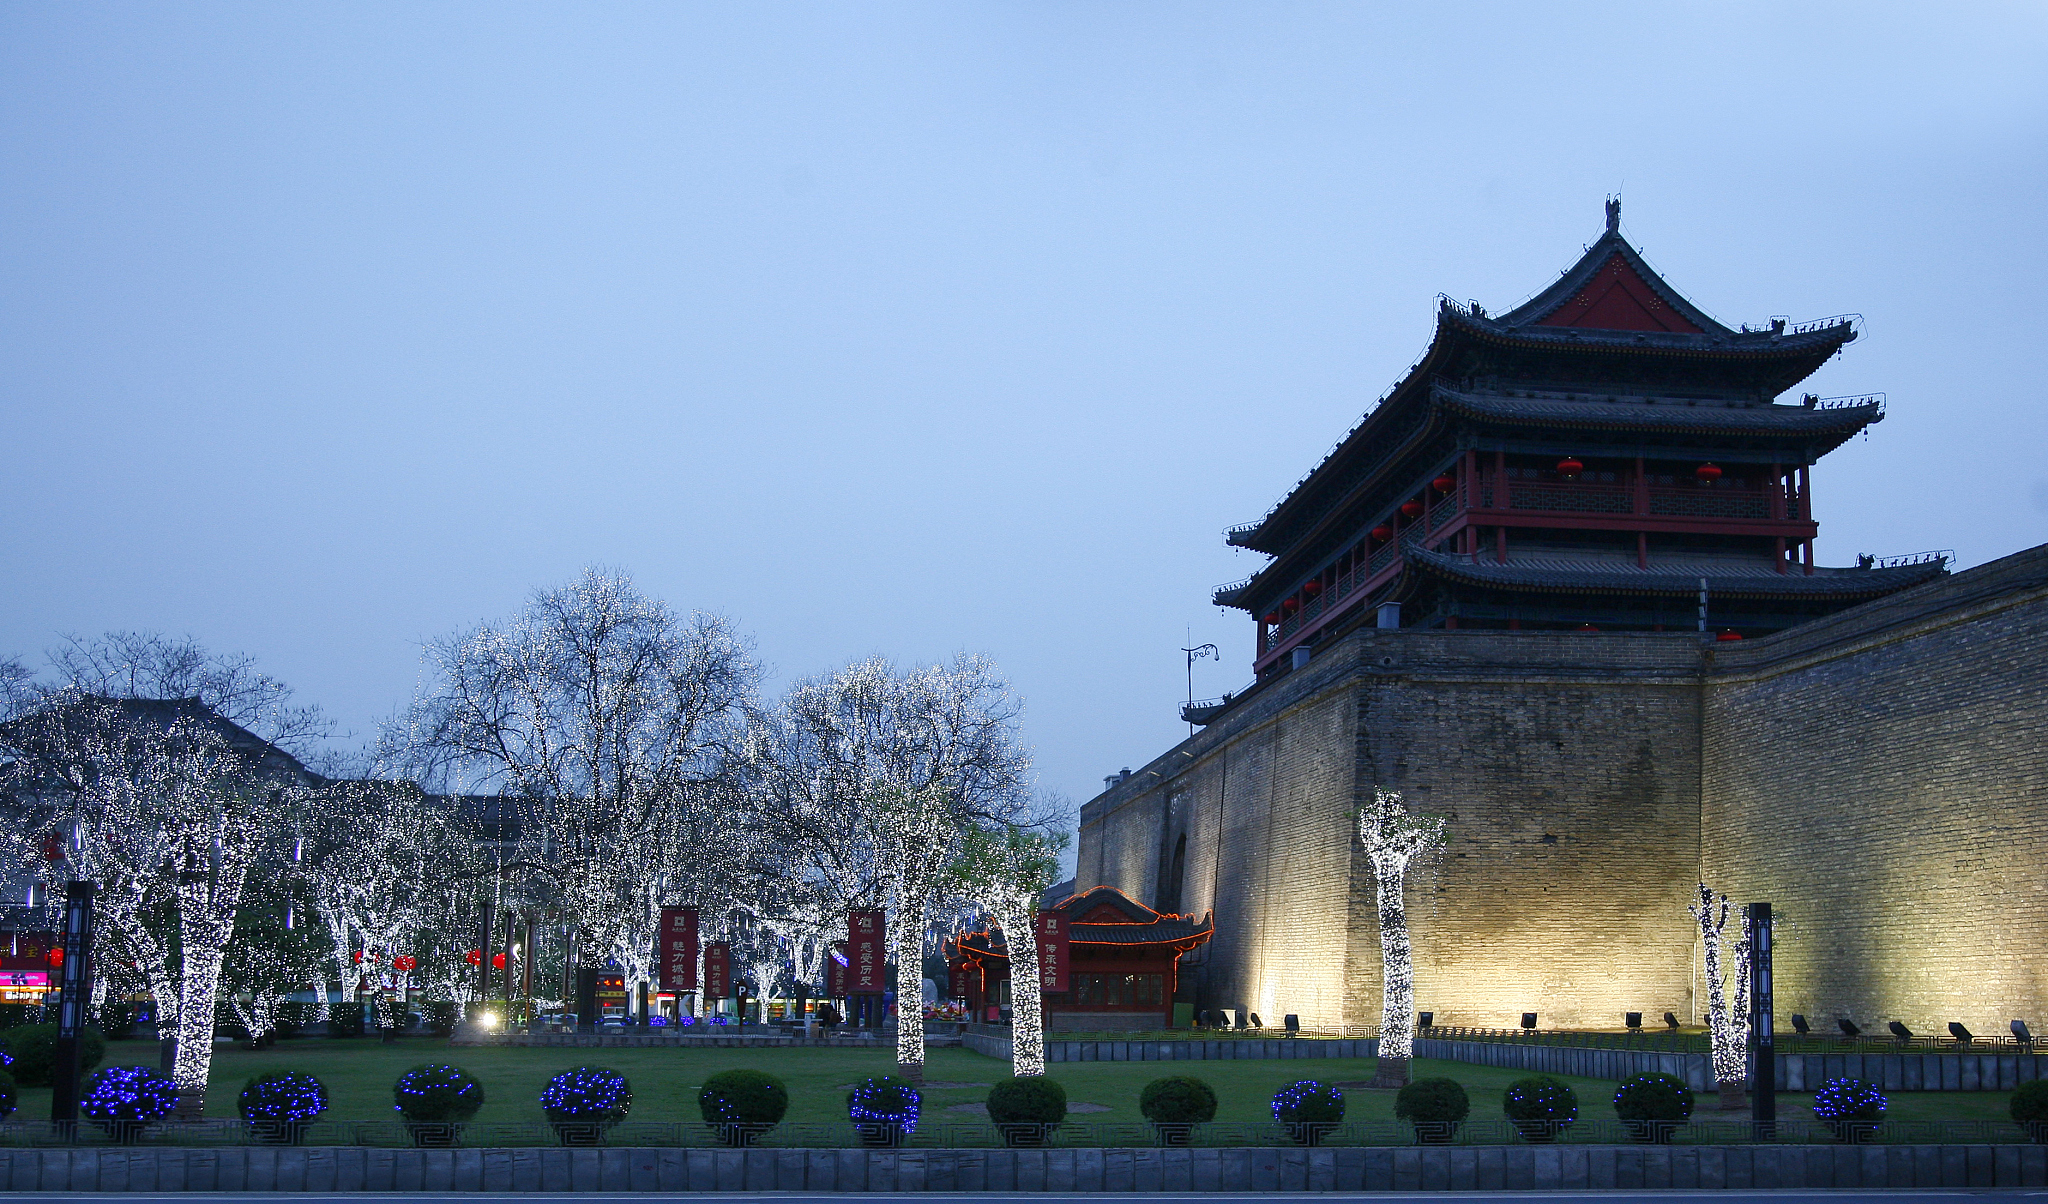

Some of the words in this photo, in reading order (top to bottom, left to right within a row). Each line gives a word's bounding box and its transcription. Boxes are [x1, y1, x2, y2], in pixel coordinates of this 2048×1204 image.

[672, 941, 685, 985] 魅力城墙
[860, 942, 873, 985] 感受历史
[1045, 944, 1057, 986] 传承文明
[738, 986, 746, 996] P
